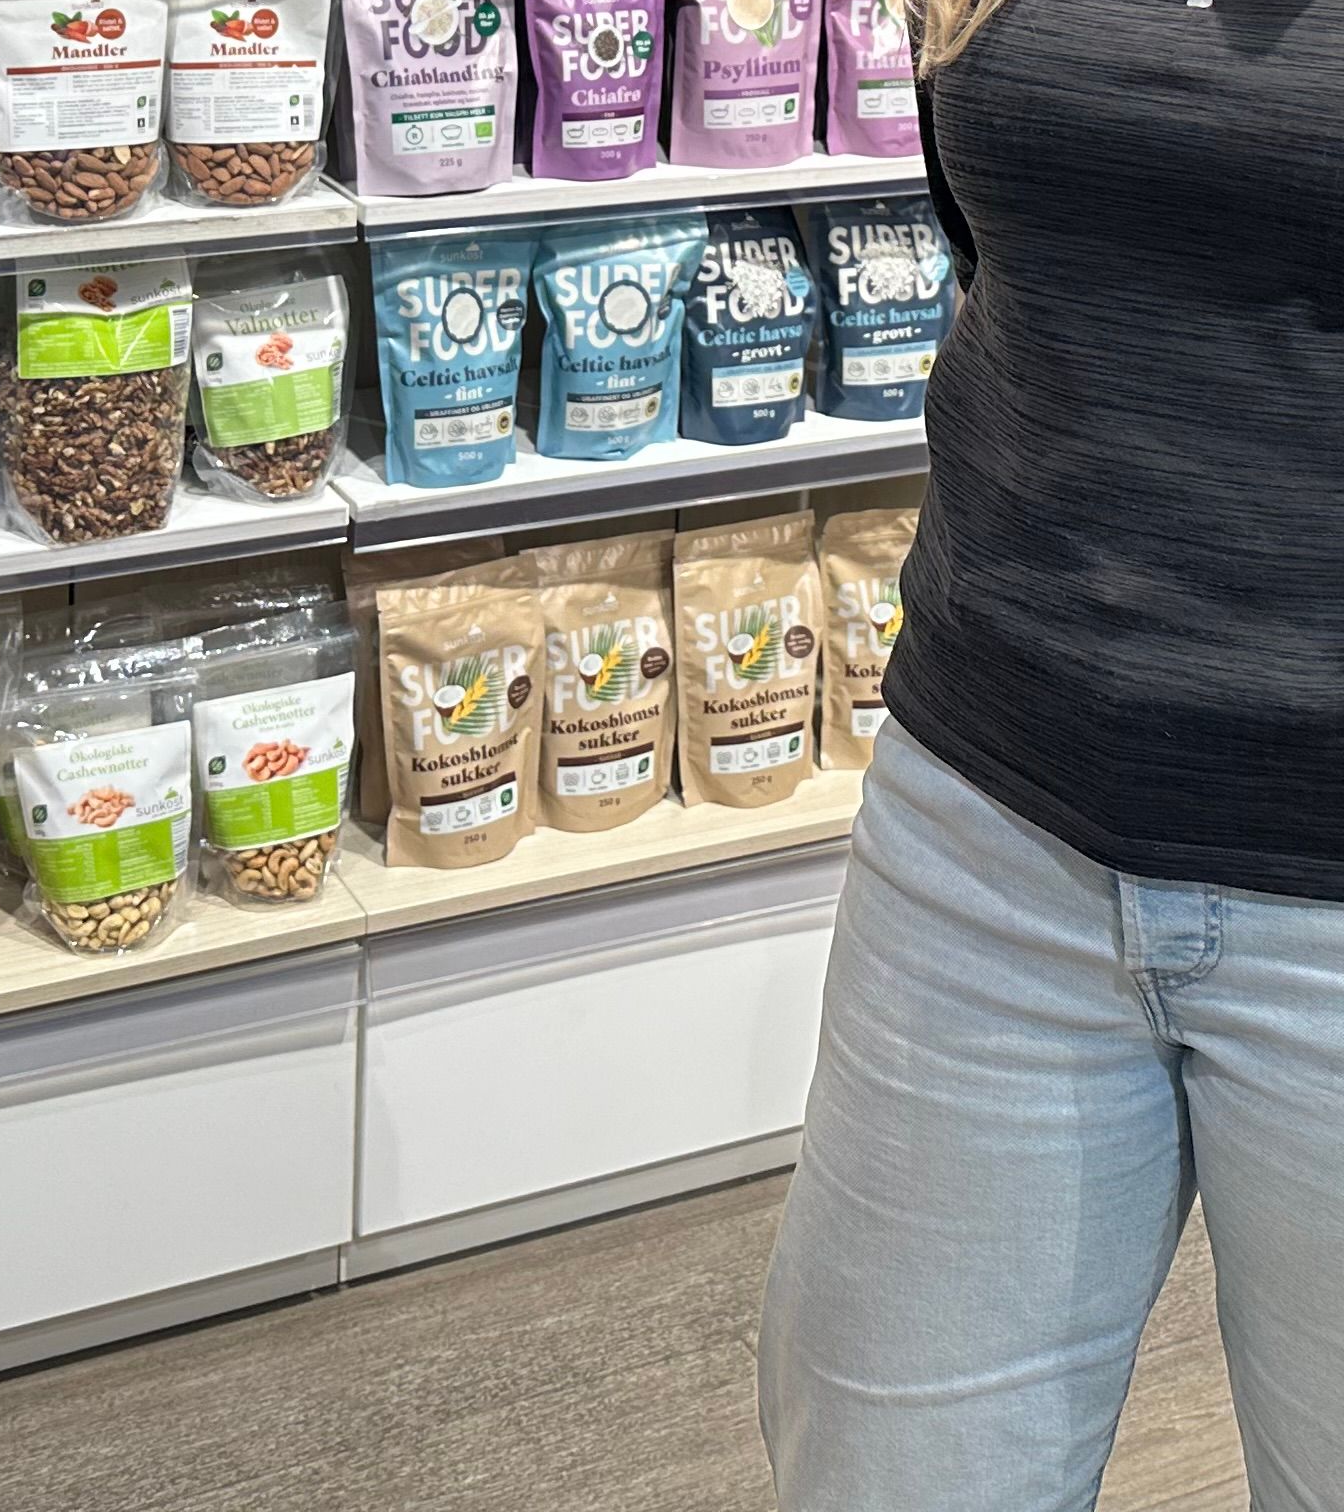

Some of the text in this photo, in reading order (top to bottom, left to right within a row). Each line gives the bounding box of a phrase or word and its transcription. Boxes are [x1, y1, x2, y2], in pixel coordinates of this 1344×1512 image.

[52, 43, 128, 60] Mandler
[210, 42, 280, 58] Mandler
[371, 64, 506, 88] Chiablanding
[703, 56, 801, 84] Psyllium
[571, 87, 642, 107] Chiafrø
[397, 267, 523, 318] SUPER
[830, 308, 886, 328] Celtic
[697, 327, 757, 347] Celtic
[871, 325, 914, 345] grovt
[559, 353, 616, 373] Celtic
[740, 343, 783, 364] grovt
[399, 366, 461, 388] Celtic
[703, 683, 810, 715] Kokosblomst
[232, 705, 317, 731] Cashewnøtter
[550, 703, 661, 735] Kokosblomst
[730, 707, 787, 730] sukker
[578, 728, 641, 752] sukker
[69, 744, 134, 765] Økologiske
[411, 734, 519, 773] Kokosblomst
[56, 757, 150, 783] Cashewnøtter
[441, 760, 501, 788] sukker
[135, 795, 185, 817] sunkost
